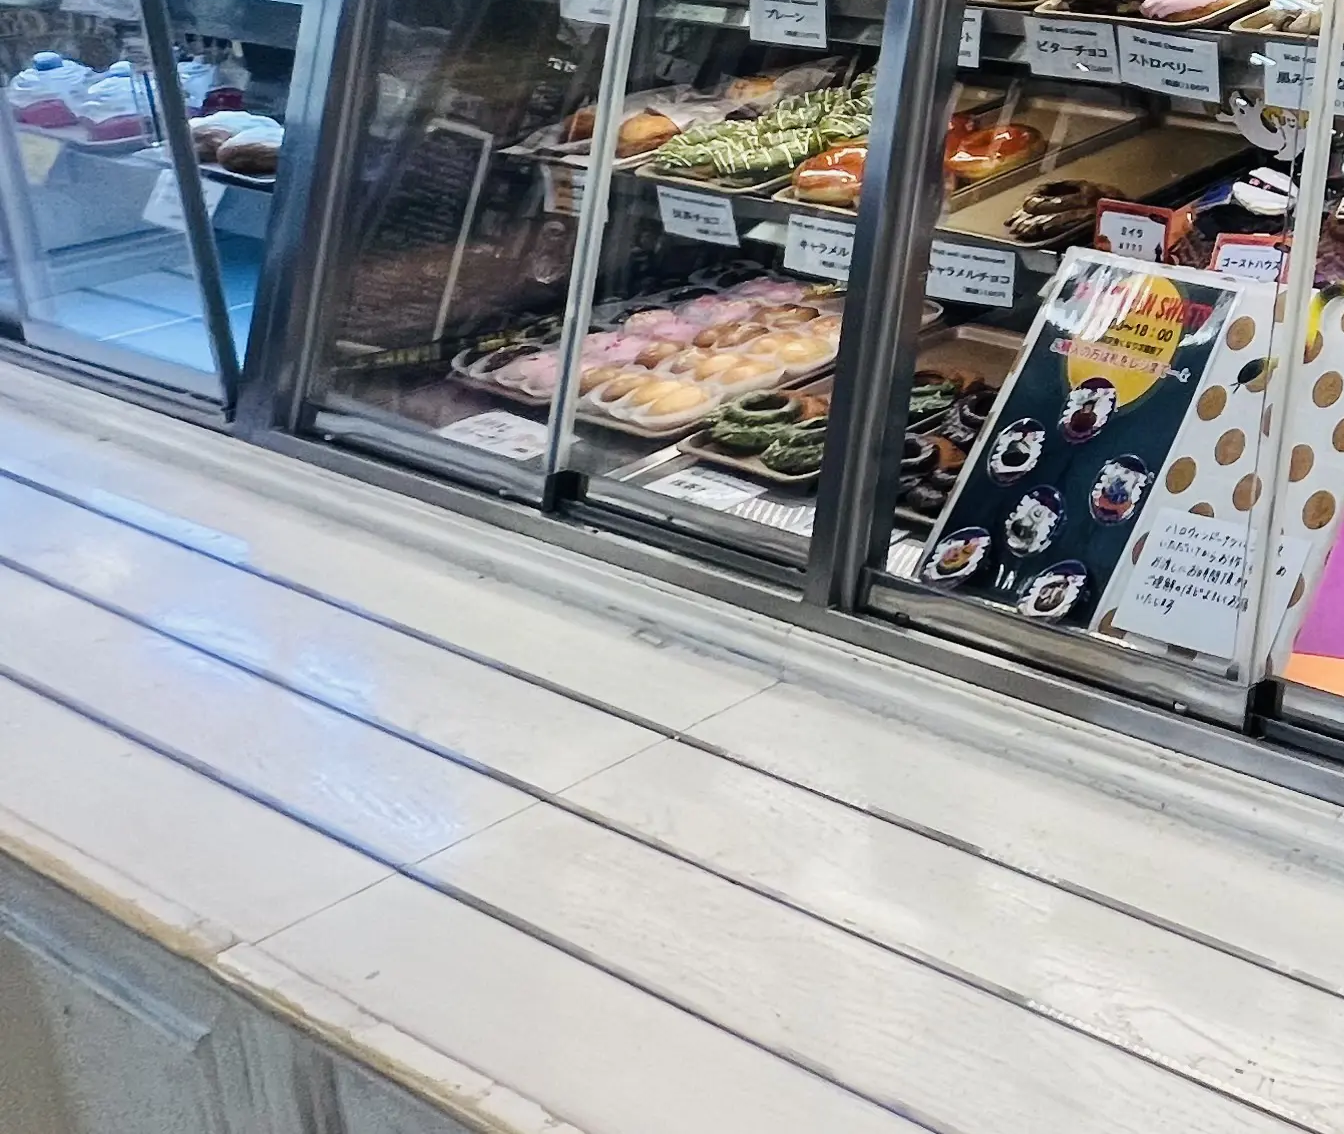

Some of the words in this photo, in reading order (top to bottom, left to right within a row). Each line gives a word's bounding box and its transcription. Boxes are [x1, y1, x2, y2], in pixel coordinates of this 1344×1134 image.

[1037, 40, 1107, 57] ビターチョコ
[1129, 53, 1203, 74] ストロベリー
[1223, 257, 1281, 269] ゴーストハウス
